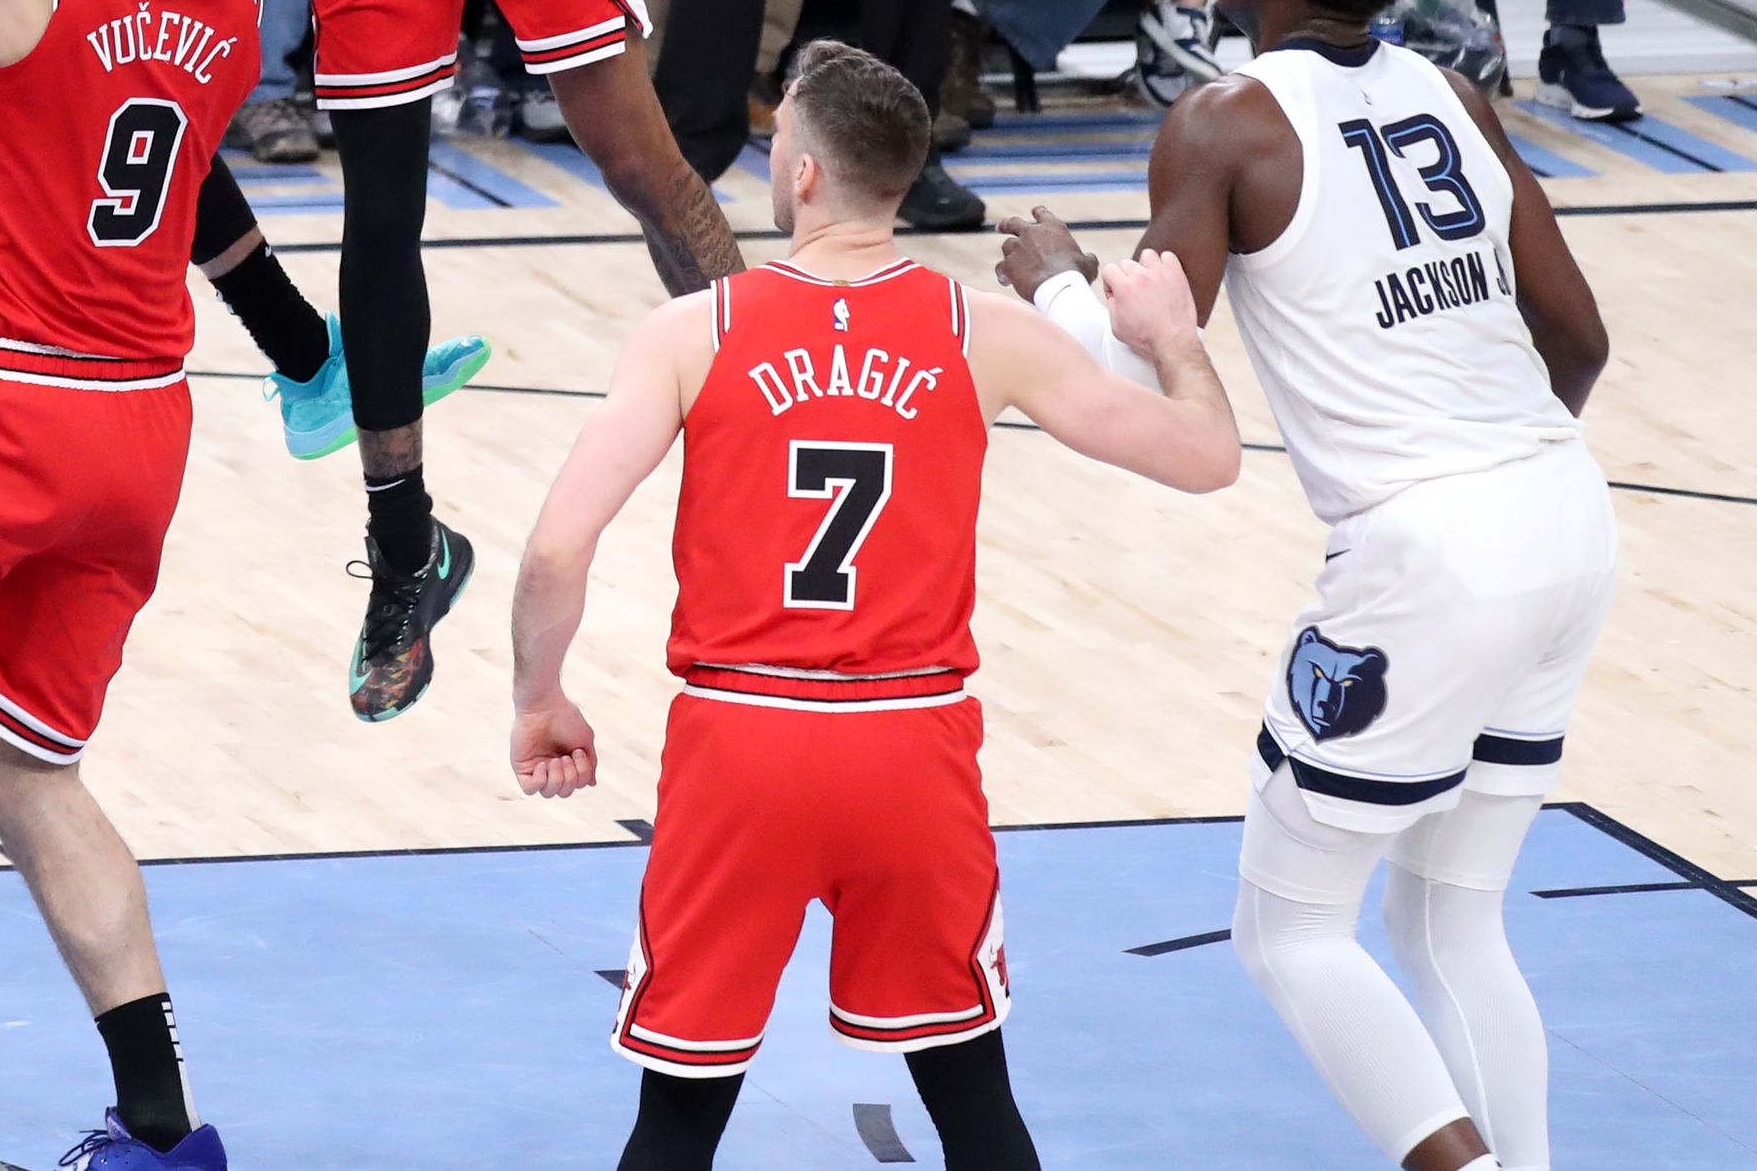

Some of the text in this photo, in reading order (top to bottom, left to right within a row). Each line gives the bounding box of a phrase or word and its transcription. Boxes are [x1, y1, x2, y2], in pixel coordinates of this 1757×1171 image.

[86, 1, 238, 85] VUČEVIĆ
[86, 96, 189, 248] 9
[1337, 113, 1486, 251] 13
[1374, 251, 1490, 329] JACKSON
[747, 344, 944, 420] DRAGIĆ
[782, 439, 894, 611] 7
